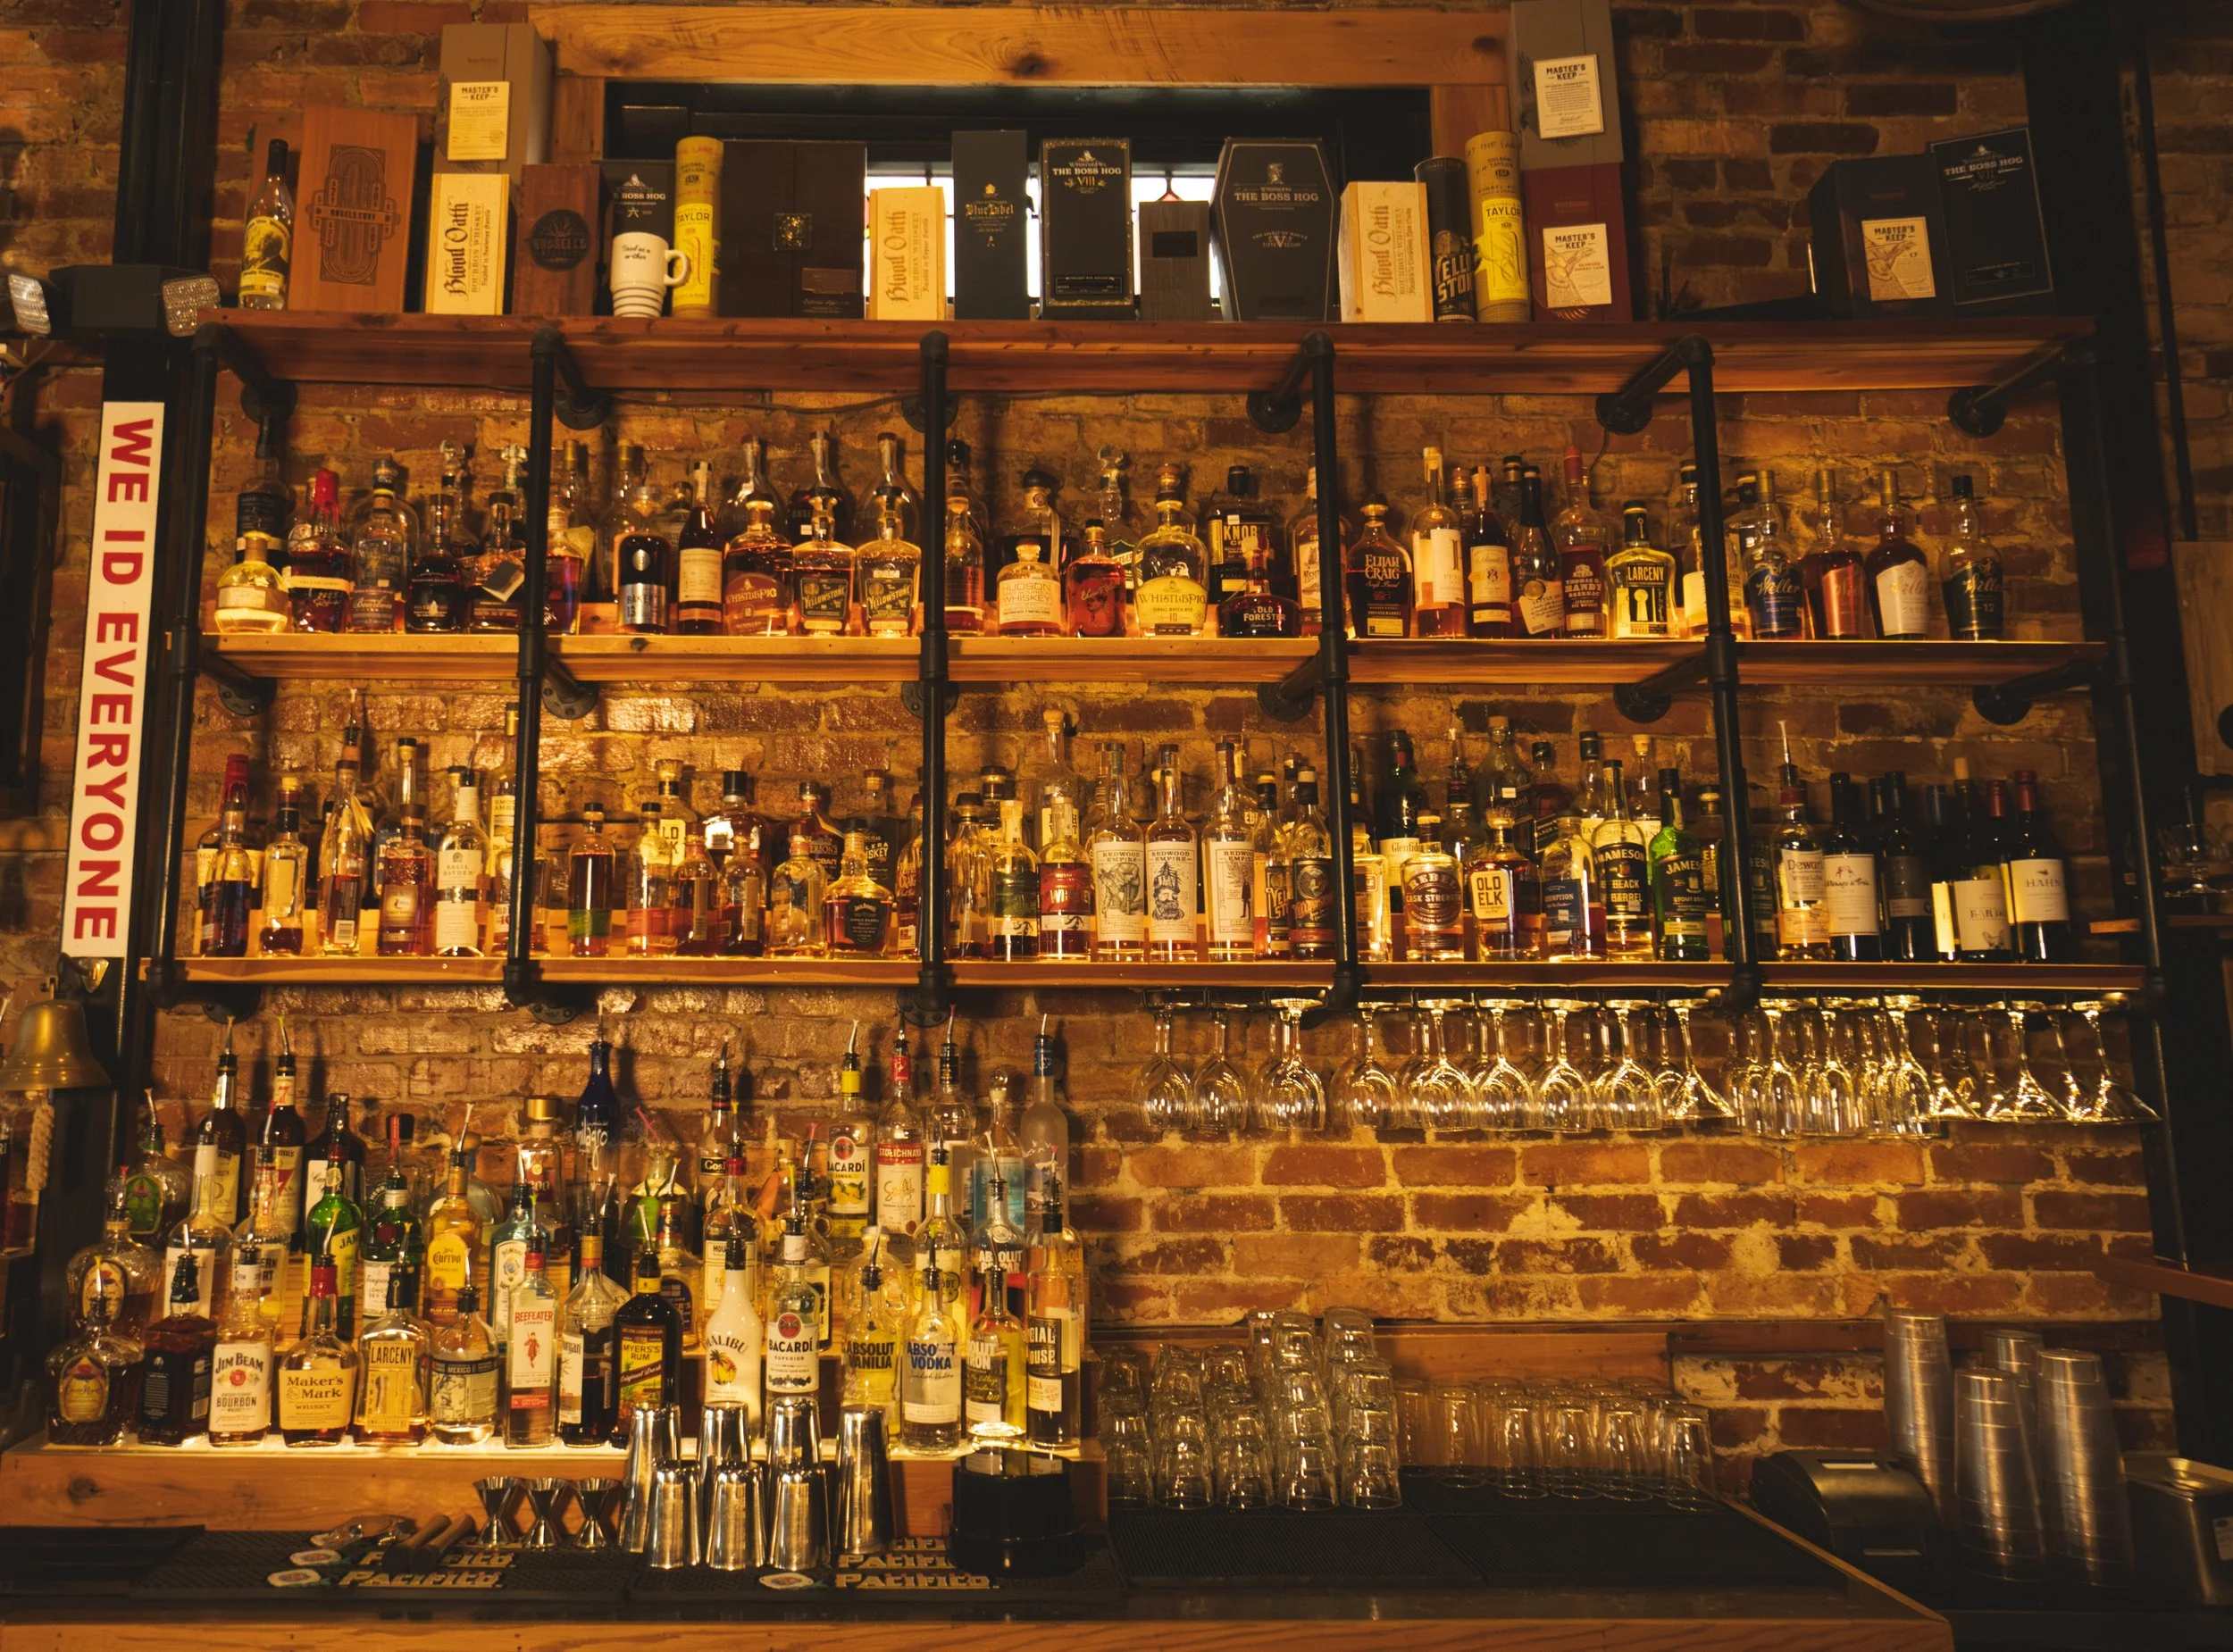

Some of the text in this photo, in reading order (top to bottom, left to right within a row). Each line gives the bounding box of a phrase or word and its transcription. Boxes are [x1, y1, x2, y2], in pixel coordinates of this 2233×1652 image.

[1546, 63, 1586, 75] MASTER'S
[1557, 73, 1577, 81] KEEP
[1052, 168, 1122, 176] THE BOSS HOG
[1944, 156, 2023, 177] THE BOSS HOG
[1077, 176, 1095, 186] VIII
[622, 192, 665, 200] BOSS HOG
[1235, 193, 1319, 202] THE BOSS HOG
[676, 212, 710, 223] TAYLOR
[1874, 225, 1915, 235] MASTER'S
[1555, 232, 1595, 243] MASTER'S
[1886, 234, 1906, 242] KEEP
[443, 202, 469, 298] Blood Oath
[1367, 206, 1396, 297] Blood Oath
[1565, 242, 1585, 250] KEEP
[883, 211, 909, 302] Blood Oath
[1224, 525, 1258, 540] KNOB
[1365, 555, 1400, 569] ELIJAH
[1365, 566, 1400, 580] CRAIG
[1627, 565, 1664, 581] LARCENY
[1003, 583, 1050, 591] HUDSON
[1564, 583, 1602, 594] HANDY
[1756, 574, 1800, 596] Weller
[802, 587, 846, 609] YELLOWSTONE
[867, 587, 910, 610] YELLOWSTONE
[1003, 595, 1050, 603] WHISKEY
[1138, 593, 1206, 605] WHISTLEPIG
[1257, 605, 1274, 613] OLD
[1169, 613, 1178, 622] 10
[1243, 613, 1286, 622] FORESTER
[73, 418, 155, 940] WE ID EVERYONE
[662, 827, 679, 839] LD
[809, 846, 838, 854] ERSON'S
[865, 847, 888, 860] ISKEY
[1392, 842, 1419, 853] Glenfid
[1665, 860, 1702, 875] JAMES
[1787, 859, 1823, 872] Dewar
[1409, 872, 1459, 890] REBEL
[1476, 876, 1501, 891] OLD
[1611, 880, 1640, 889] BLACK
[2026, 878, 2062, 889] HAHN
[1407, 894, 1462, 903] CASK STRENGTH
[1477, 891, 1503, 906] ELK
[1610, 893, 1643, 903] BARREL
[278, 1086, 290, 1104] 7
[432, 1252, 462, 1265] Cuervo
[979, 1250, 1023, 1263] ABOLUT
[514, 1310, 554, 1323] BEEFEATER
[1030, 1327, 1057, 1344] CIAL
[623, 1344, 661, 1353] MYERS'S
[769, 1337, 813, 1353] BACARDÍ
[846, 1341, 895, 1356] ABSOLUT
[907, 1342, 957, 1356] ABSOT
[969, 1341, 995, 1356] OLUT
[371, 1347, 414, 1364] LARCENY
[631, 1353, 650, 1361] RUM
[1030, 1349, 1057, 1365] OUSE
[215, 1352, 263, 1374] JIM BEAM
[849, 1356, 893, 1369] VANILIA
[911, 1357, 952, 1370] VODKA
[969, 1356, 991, 1371] RON
[287, 1376, 344, 1387] Maker's
[301, 1388, 342, 1399] Mark
[216, 1396, 257, 1409] BOURBON
[339, 1571, 504, 1588] PACIFICO
[835, 1573, 991, 1589] PACIFICO
